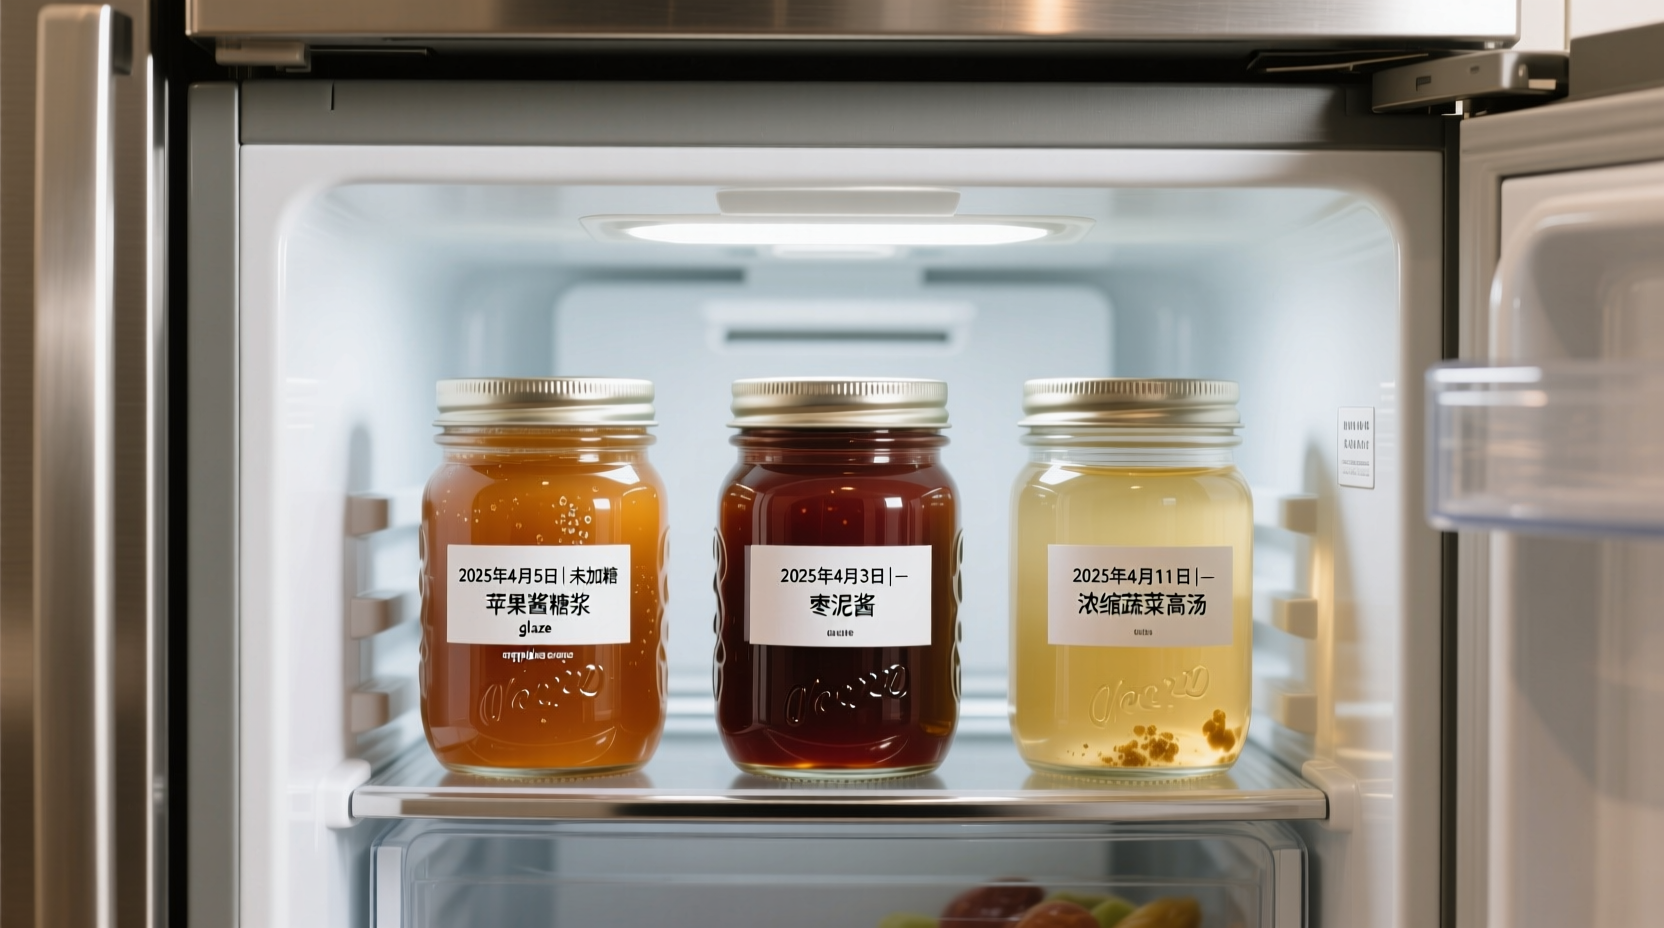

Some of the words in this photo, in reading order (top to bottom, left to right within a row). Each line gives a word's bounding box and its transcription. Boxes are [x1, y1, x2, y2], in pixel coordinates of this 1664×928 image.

[486, 592, 590, 616] 苹果酱糖浆
[810, 592, 875, 617] 枣泥酱
[1078, 591, 1206, 616] 浓缩蔬菜高汤
[519, 620, 552, 637] glaze
